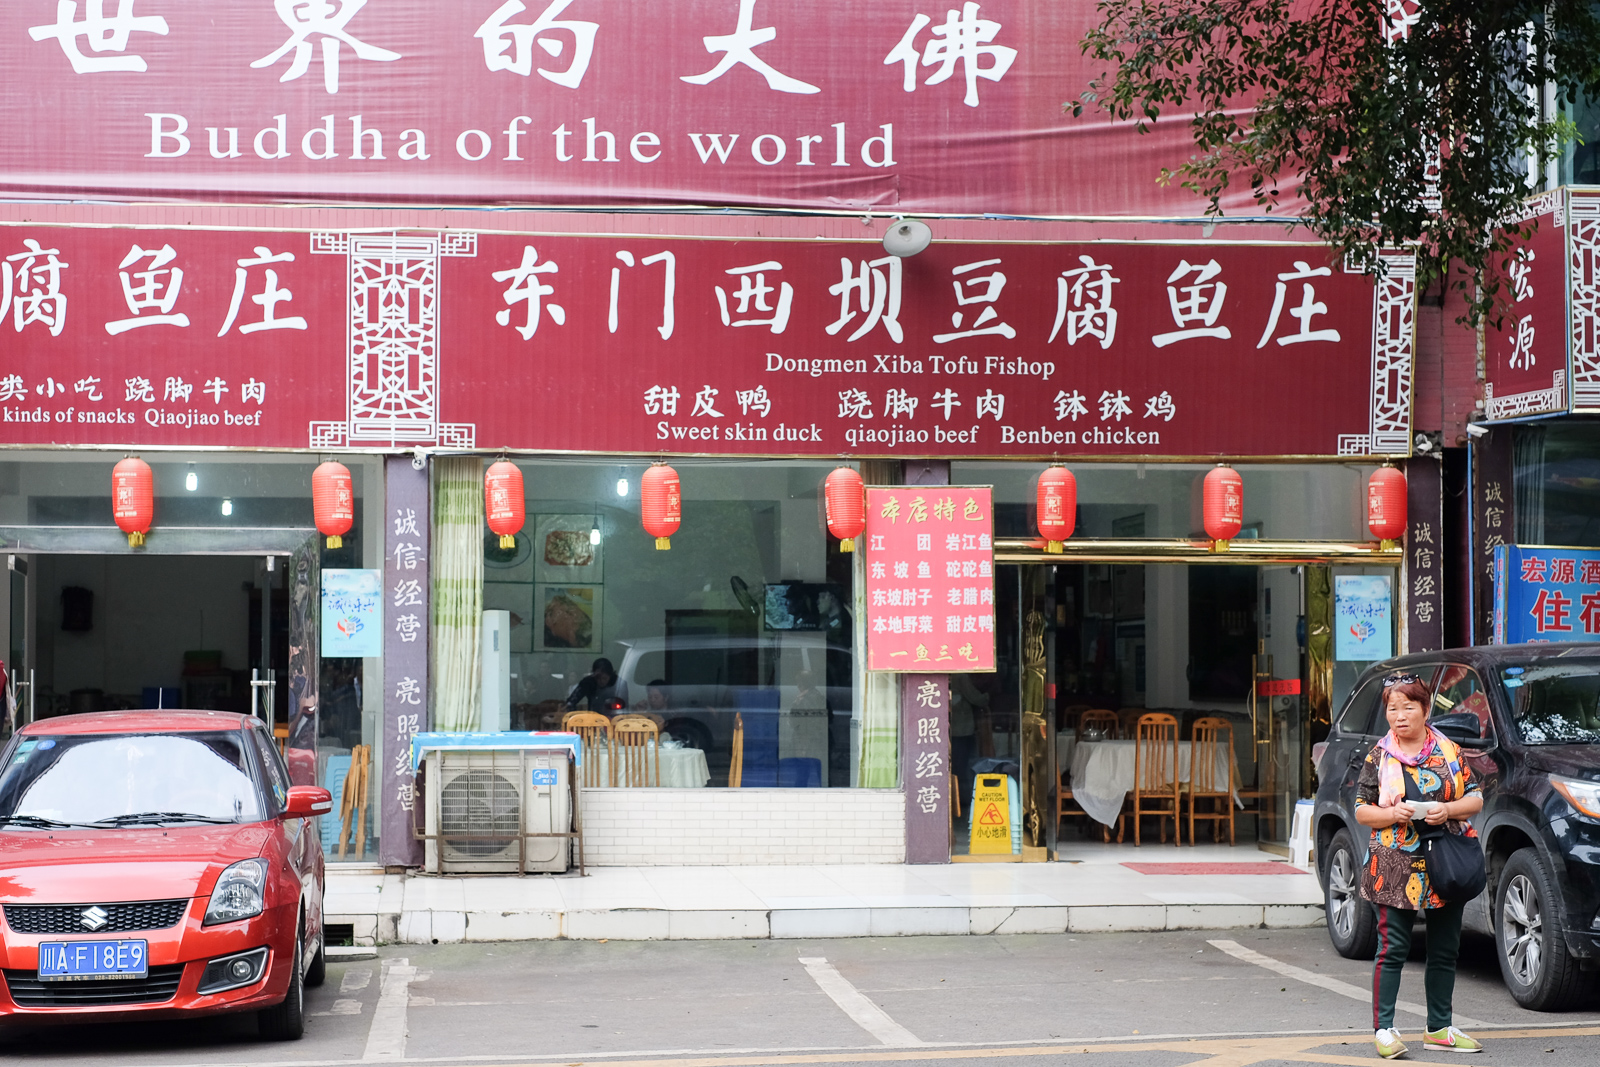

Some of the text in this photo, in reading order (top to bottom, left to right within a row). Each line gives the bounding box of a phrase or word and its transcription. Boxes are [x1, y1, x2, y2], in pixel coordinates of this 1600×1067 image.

[27, 0, 1018, 108] 世界的大佛
[143, 112, 898, 168] Buddha of the world
[0, 238, 308, 338] 腐鱼庄
[491, 244, 1341, 350] 东门西坝豆腐鱼庄
[1508, 247, 1536, 371] 宏源
[765, 352, 1056, 381] Dongmen Xiba Tofu Fishop
[0, 373, 266, 406] 类小吃 跷脚牛肉
[643, 384, 1176, 422] 甜皮鸭 跷脚牛肉 钵钵鸡
[3, 406, 263, 429] kinds of snacks Qiaojiao beef
[656, 420, 1160, 448] Sweet skin duck qiaojiao beef Benben chicken
[881, 495, 984, 525] 本店特色
[946, 533, 993, 551] 岩江鱼
[393, 507, 423, 643] 诚信经营
[871, 561, 931, 579] 东坡鱼
[1413, 522, 1436, 623] 诚信经营
[872, 587, 993, 606] 东坡肘子 老腊肉
[873, 615, 993, 634] 本地野菜 甜皮鸭
[889, 642, 979, 663] 一鱼三吃
[915, 680, 943, 814] 亮照经营
[977, 826, 1007, 838] 小心地滑
